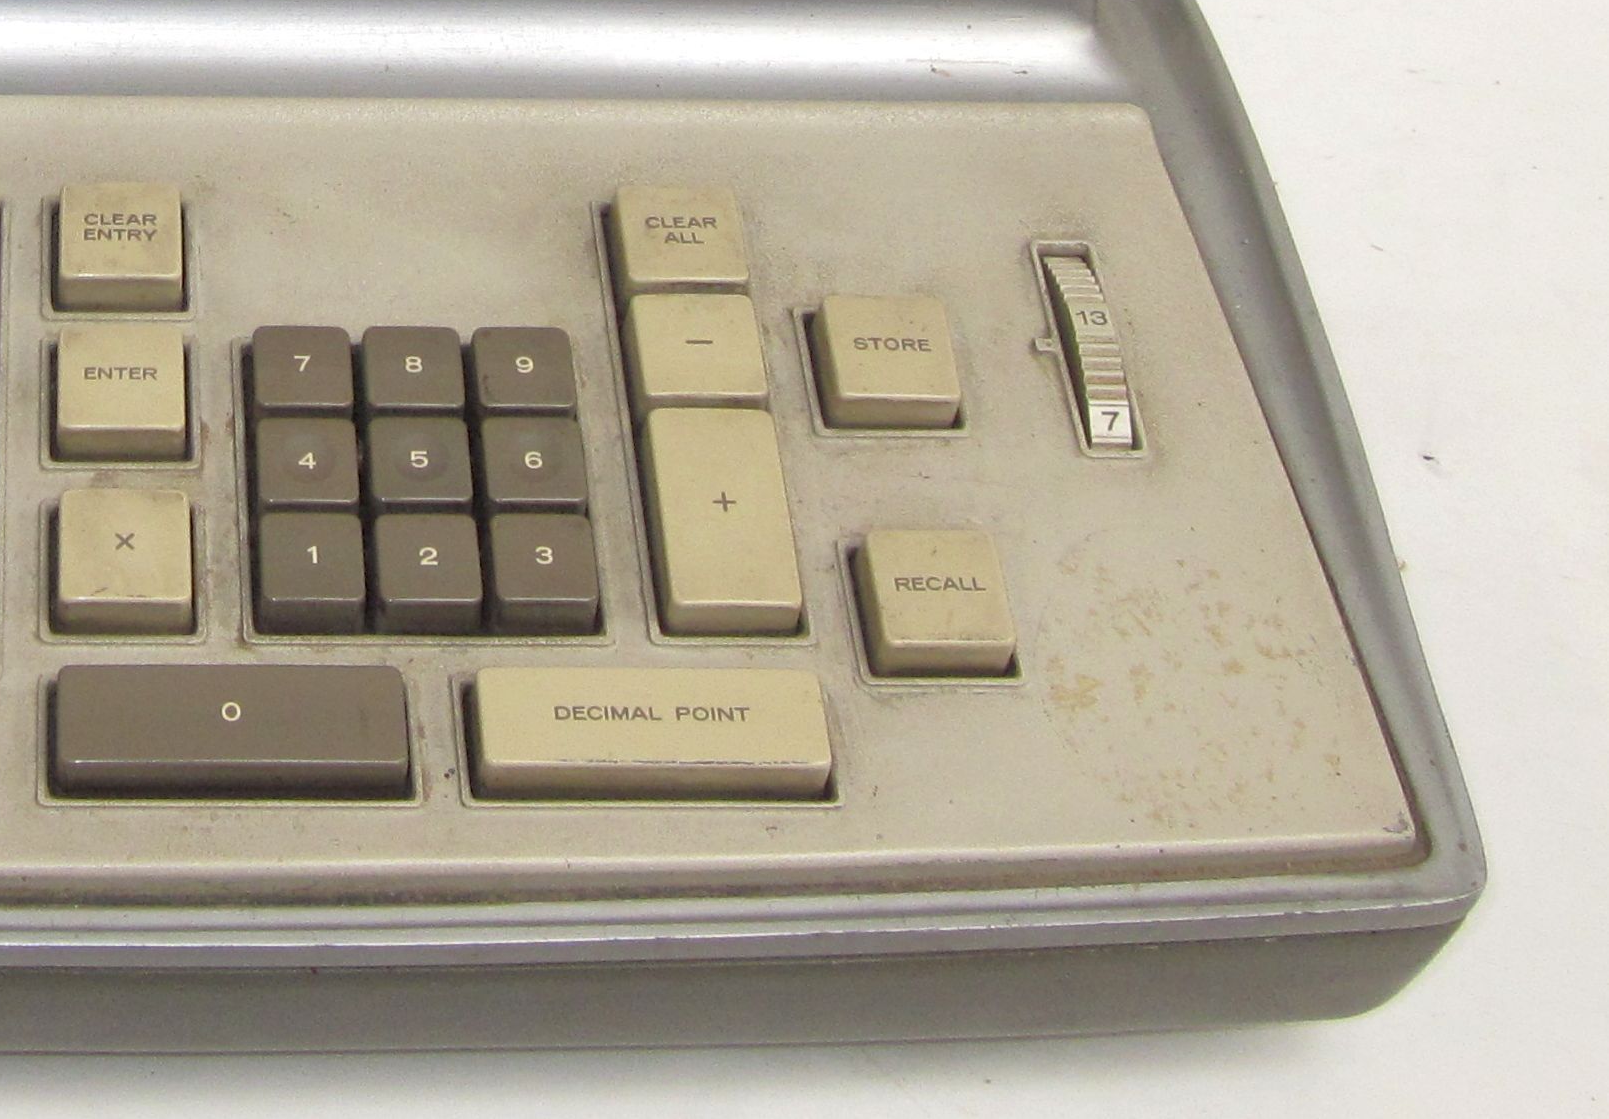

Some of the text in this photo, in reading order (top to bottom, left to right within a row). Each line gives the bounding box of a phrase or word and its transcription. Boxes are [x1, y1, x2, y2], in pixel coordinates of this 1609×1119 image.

[83, 212, 157, 226] CLEAR
[644, 216, 717, 230] CLEAR
[83, 228, 157, 242] ENTRY
[664, 231, 704, 245] ALL
[1075, 310, 1108, 326] 13
[853, 336, 932, 352] STORE
[293, 355, 311, 372] 7
[405, 355, 423, 373] 8
[515, 356, 534, 374] 9
[83, 366, 158, 380] ENTER
[1101, 411, 1120, 432] 7
[298, 452, 317, 470] 4
[410, 450, 429, 468] 5
[524, 450, 543, 469] 6
[307, 545, 318, 564] 1
[419, 546, 439, 566] 2
[535, 546, 554, 565] 3
[894, 576, 987, 592] RECALL
[553, 705, 750, 722] DECIMAL POINT
